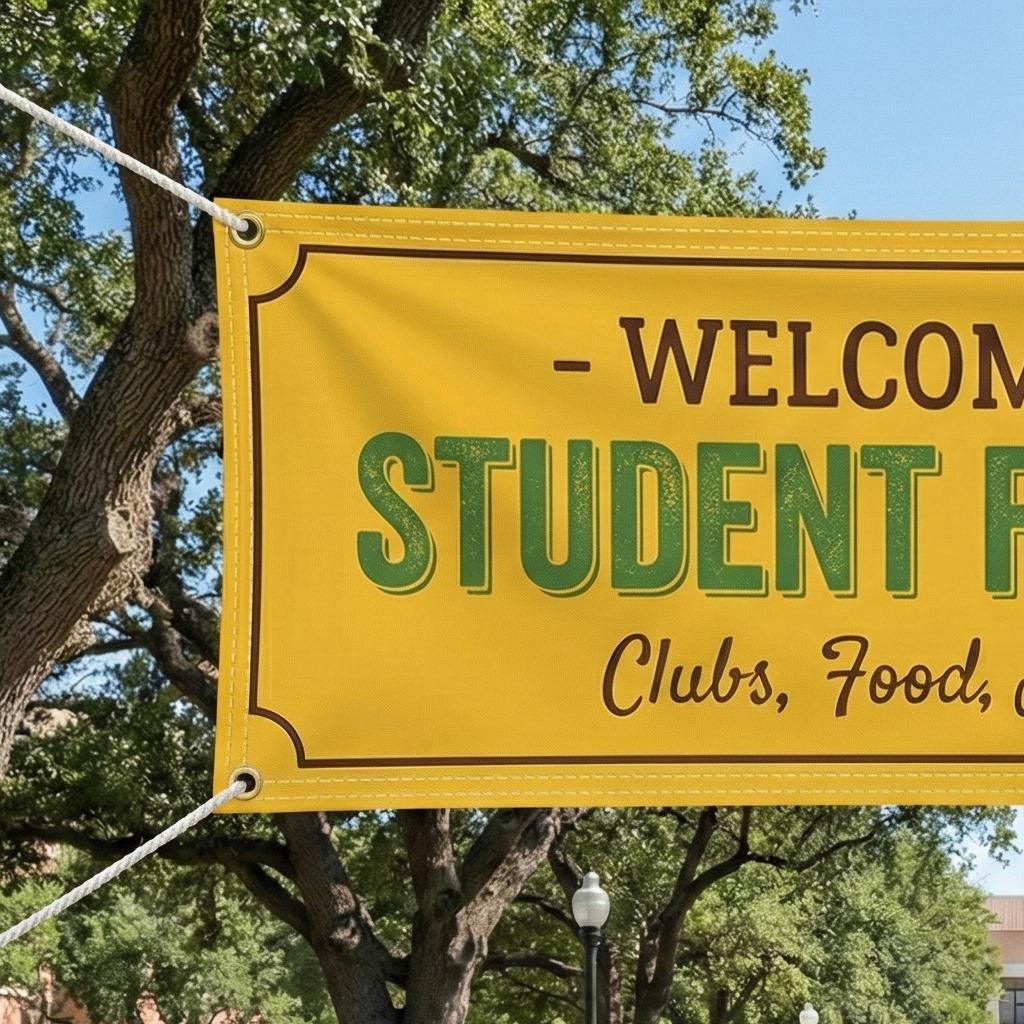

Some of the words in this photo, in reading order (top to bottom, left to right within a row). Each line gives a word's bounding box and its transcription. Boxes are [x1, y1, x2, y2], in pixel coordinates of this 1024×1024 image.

[357, 432, 943, 600] STUDENT
[602, 633, 790, 717] Clubs,
[821, 635, 993, 718] Food,
